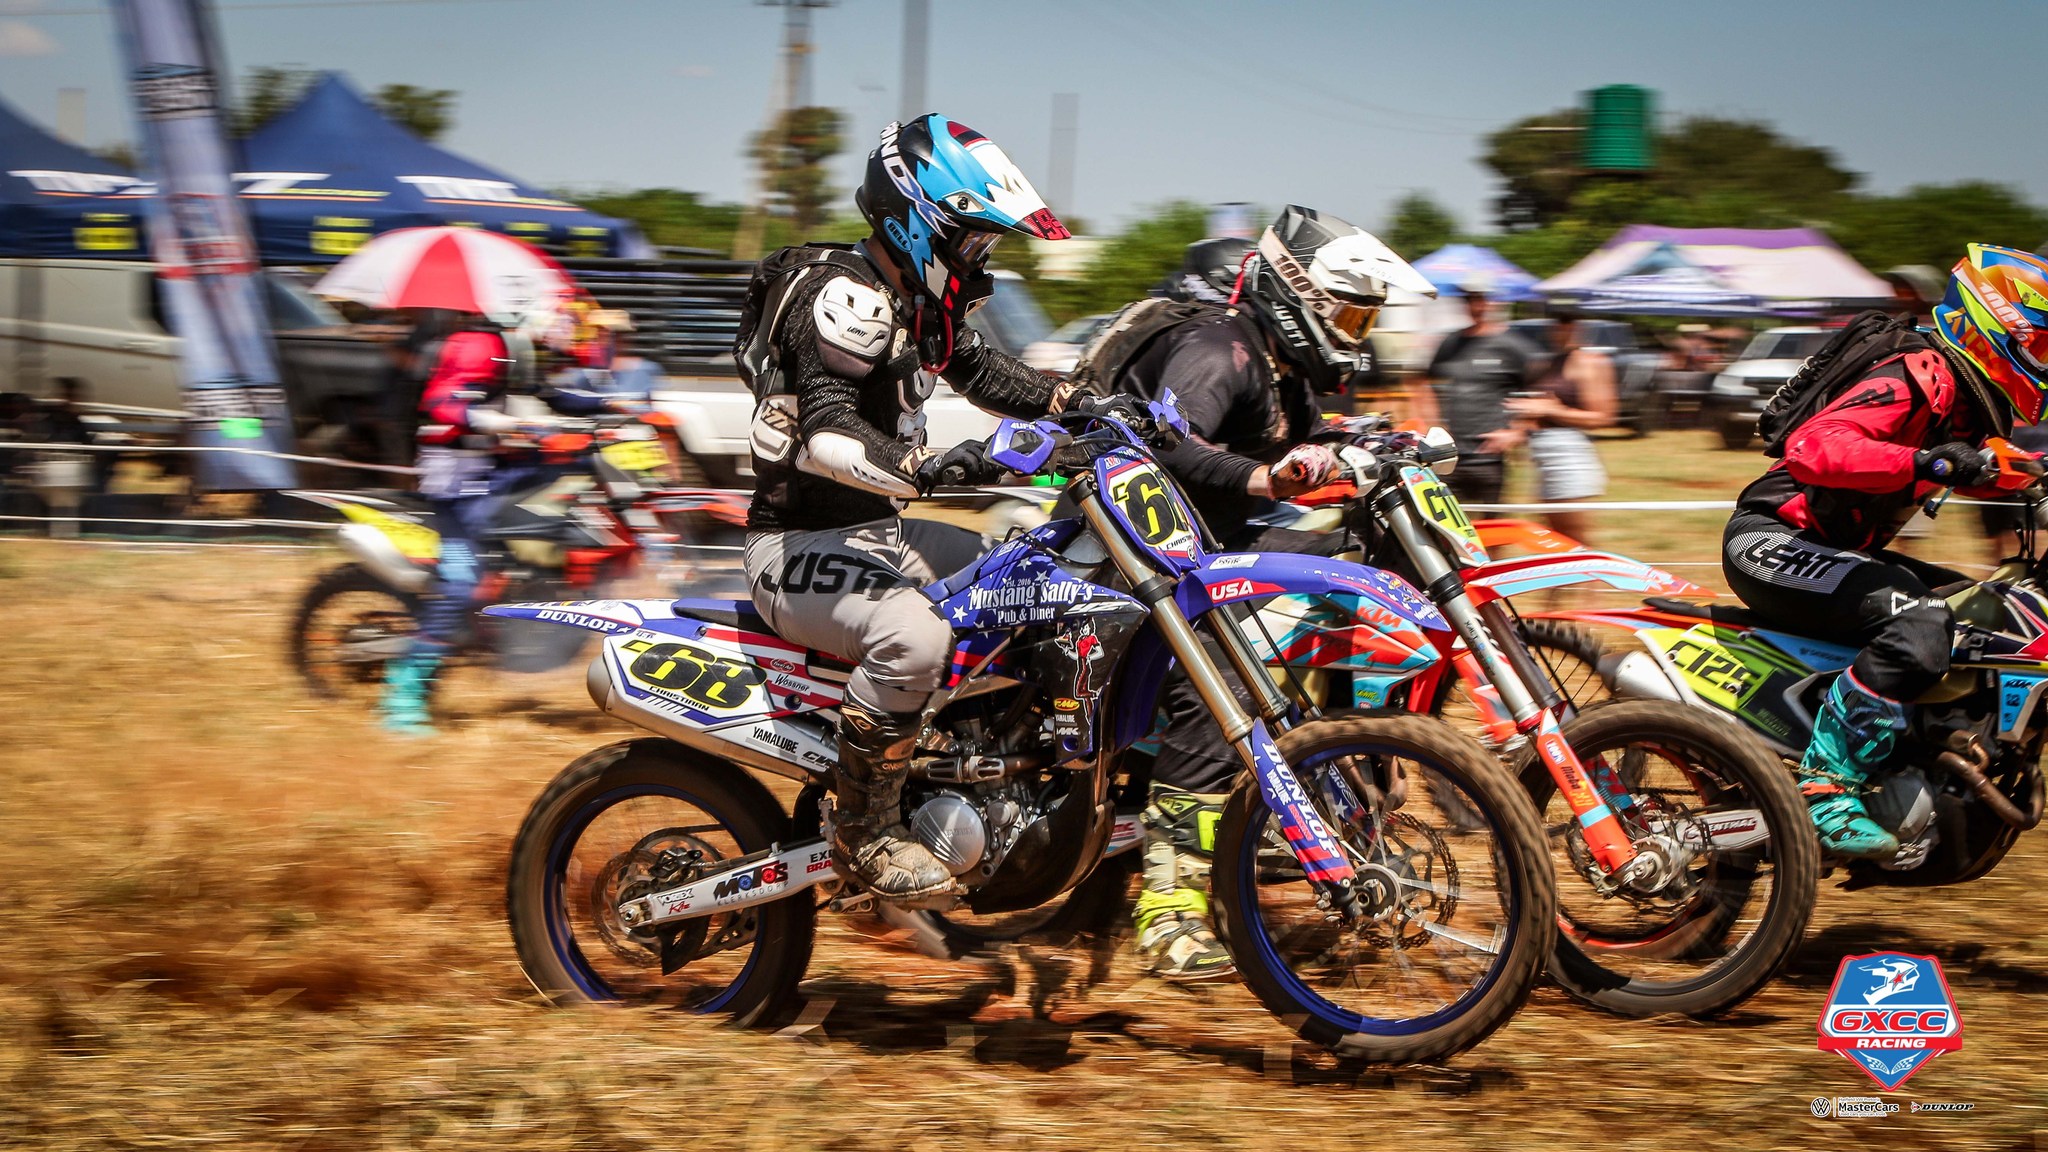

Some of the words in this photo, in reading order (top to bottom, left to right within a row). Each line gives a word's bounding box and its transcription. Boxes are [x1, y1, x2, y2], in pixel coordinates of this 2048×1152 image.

[887, 222, 907, 249] BELL
[1273, 253, 1326, 311] 100%
[1979, 282, 2030, 343] 100%
[968, 584, 1036, 611] Mustang
[1040, 581, 1097, 604] Sally's
[1211, 582, 1254, 601] USA
[536, 609, 618, 632] DUNLOP
[1018, 608, 1027, 621] &
[752, 726, 798, 754] YAMALUBE
[1261, 742, 1341, 859] DUNLOP
